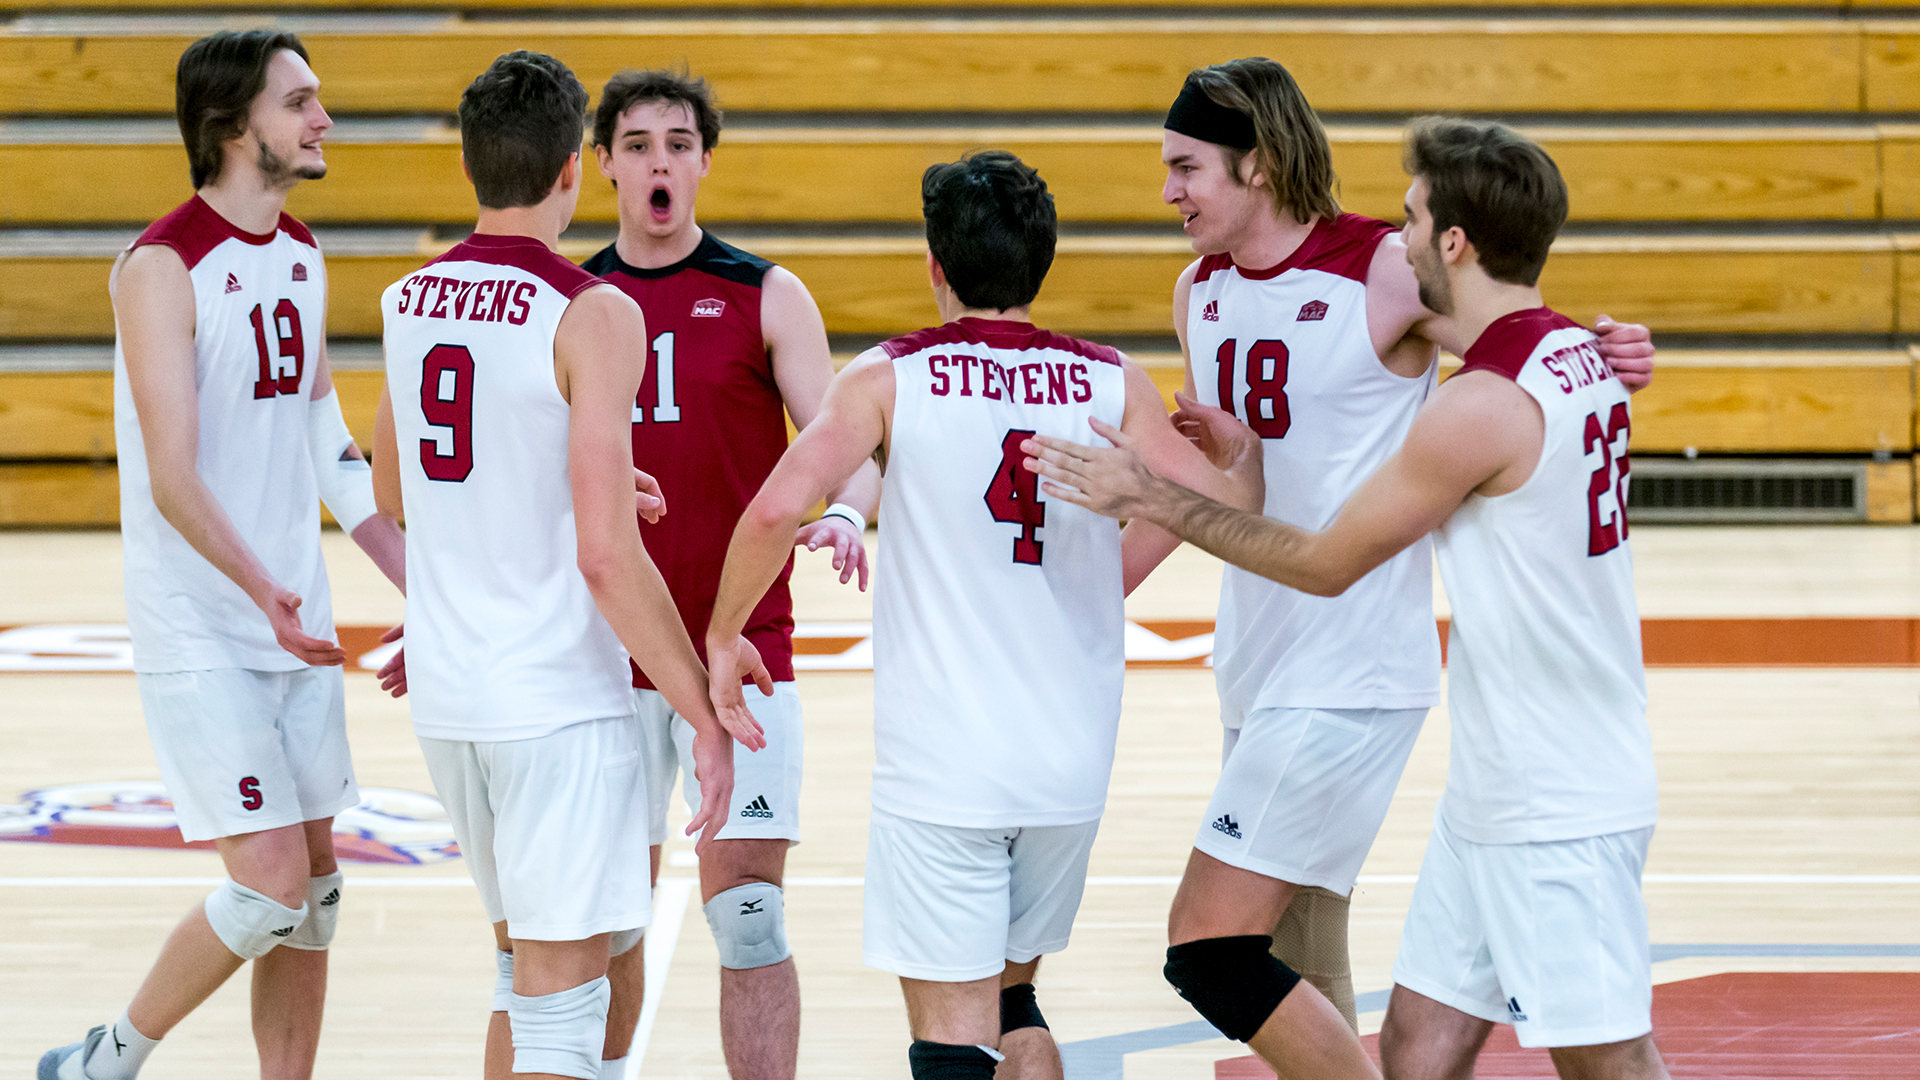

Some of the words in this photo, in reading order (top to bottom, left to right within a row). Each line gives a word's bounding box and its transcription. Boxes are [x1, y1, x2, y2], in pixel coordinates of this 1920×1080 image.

[398, 275, 538, 326] STEVENS
[694, 307, 721, 315] MAC
[1298, 311, 1325, 320] MAC
[249, 298, 304, 400] 19
[928, 354, 1092, 405] STEVENS
[1216, 338, 1291, 439] 18
[419, 343, 475, 483] 9
[983, 428, 1046, 567] 4
[239, 776, 264, 811] S
[741, 809, 774, 818] adidas
